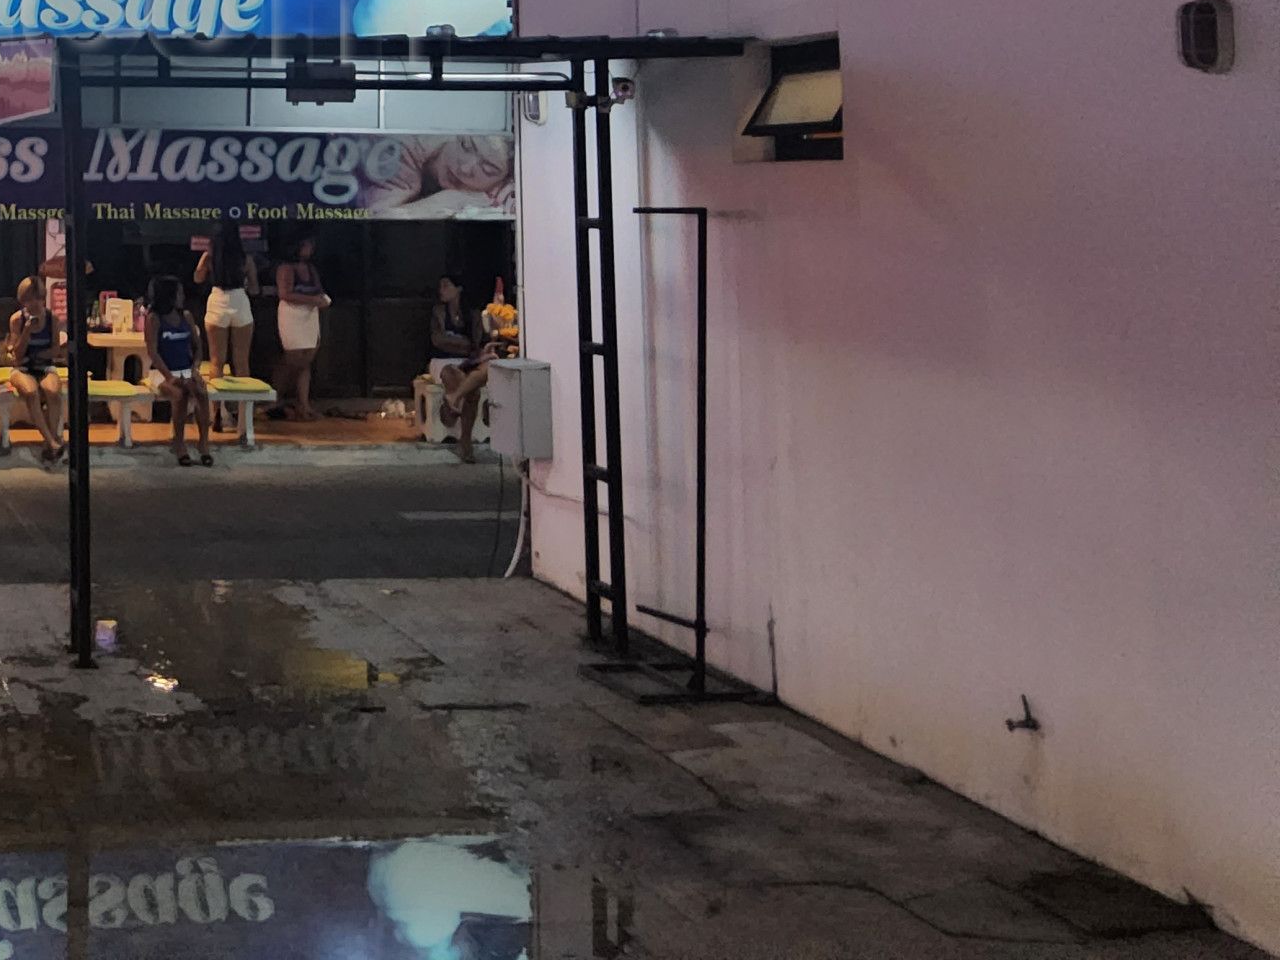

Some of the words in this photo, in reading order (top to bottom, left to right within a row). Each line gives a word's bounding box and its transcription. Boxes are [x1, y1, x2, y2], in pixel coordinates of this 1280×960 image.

[83, 128, 401, 204] Massage
[92, 202, 136, 221] Thai
[144, 202, 222, 221] Massage
[246, 202, 288, 221] Foot
